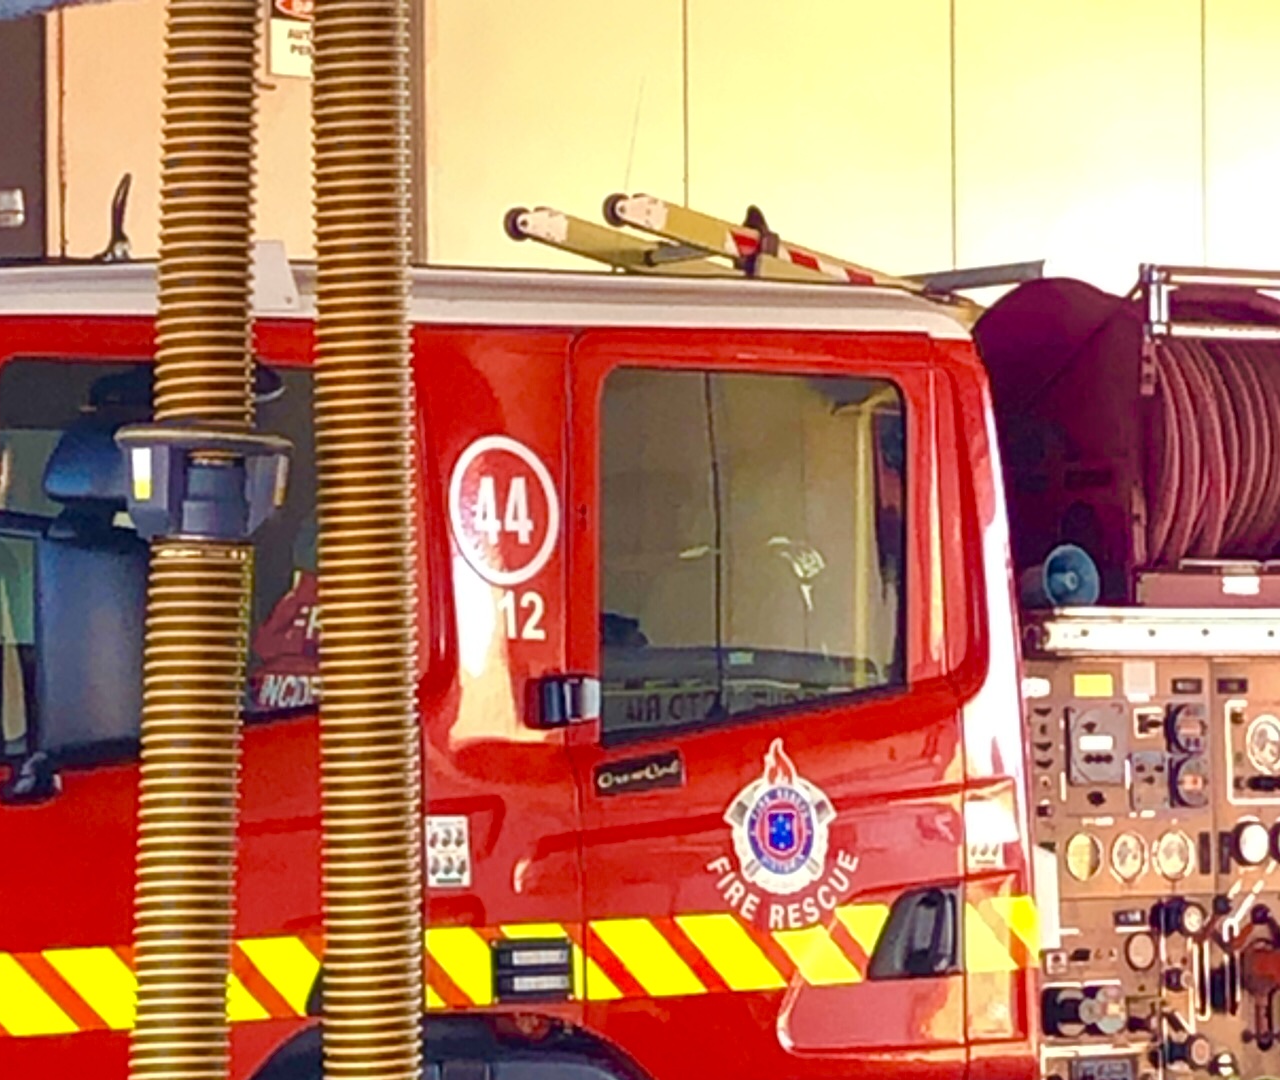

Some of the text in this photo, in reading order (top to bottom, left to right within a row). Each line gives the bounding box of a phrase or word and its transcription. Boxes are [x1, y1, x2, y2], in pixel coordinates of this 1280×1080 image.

[474, 475, 534, 545] 44
[498, 591, 546, 640] 12
[706, 850, 859, 929] FIRE RESCUE
